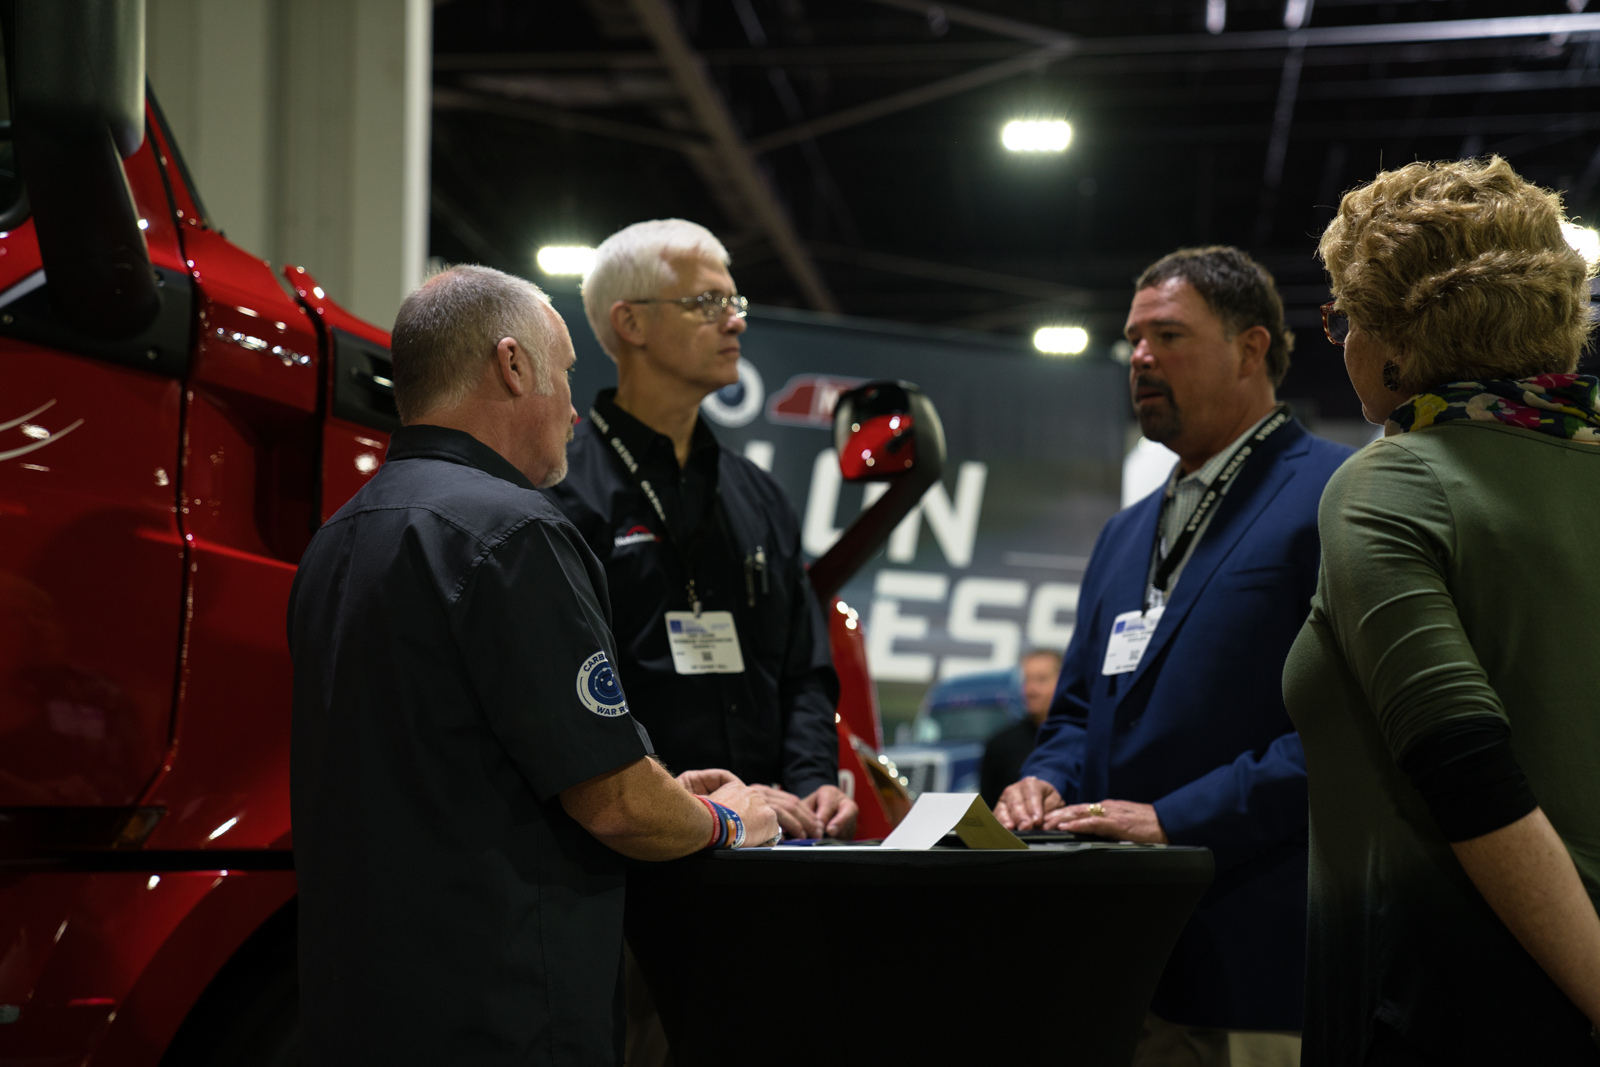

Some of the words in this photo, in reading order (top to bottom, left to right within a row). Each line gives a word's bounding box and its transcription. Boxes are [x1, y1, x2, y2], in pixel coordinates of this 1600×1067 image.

[1219, 446, 1252, 481] VOLVO
[1186, 490, 1216, 531] VOLVO
[596, 705, 617, 715] WAR
